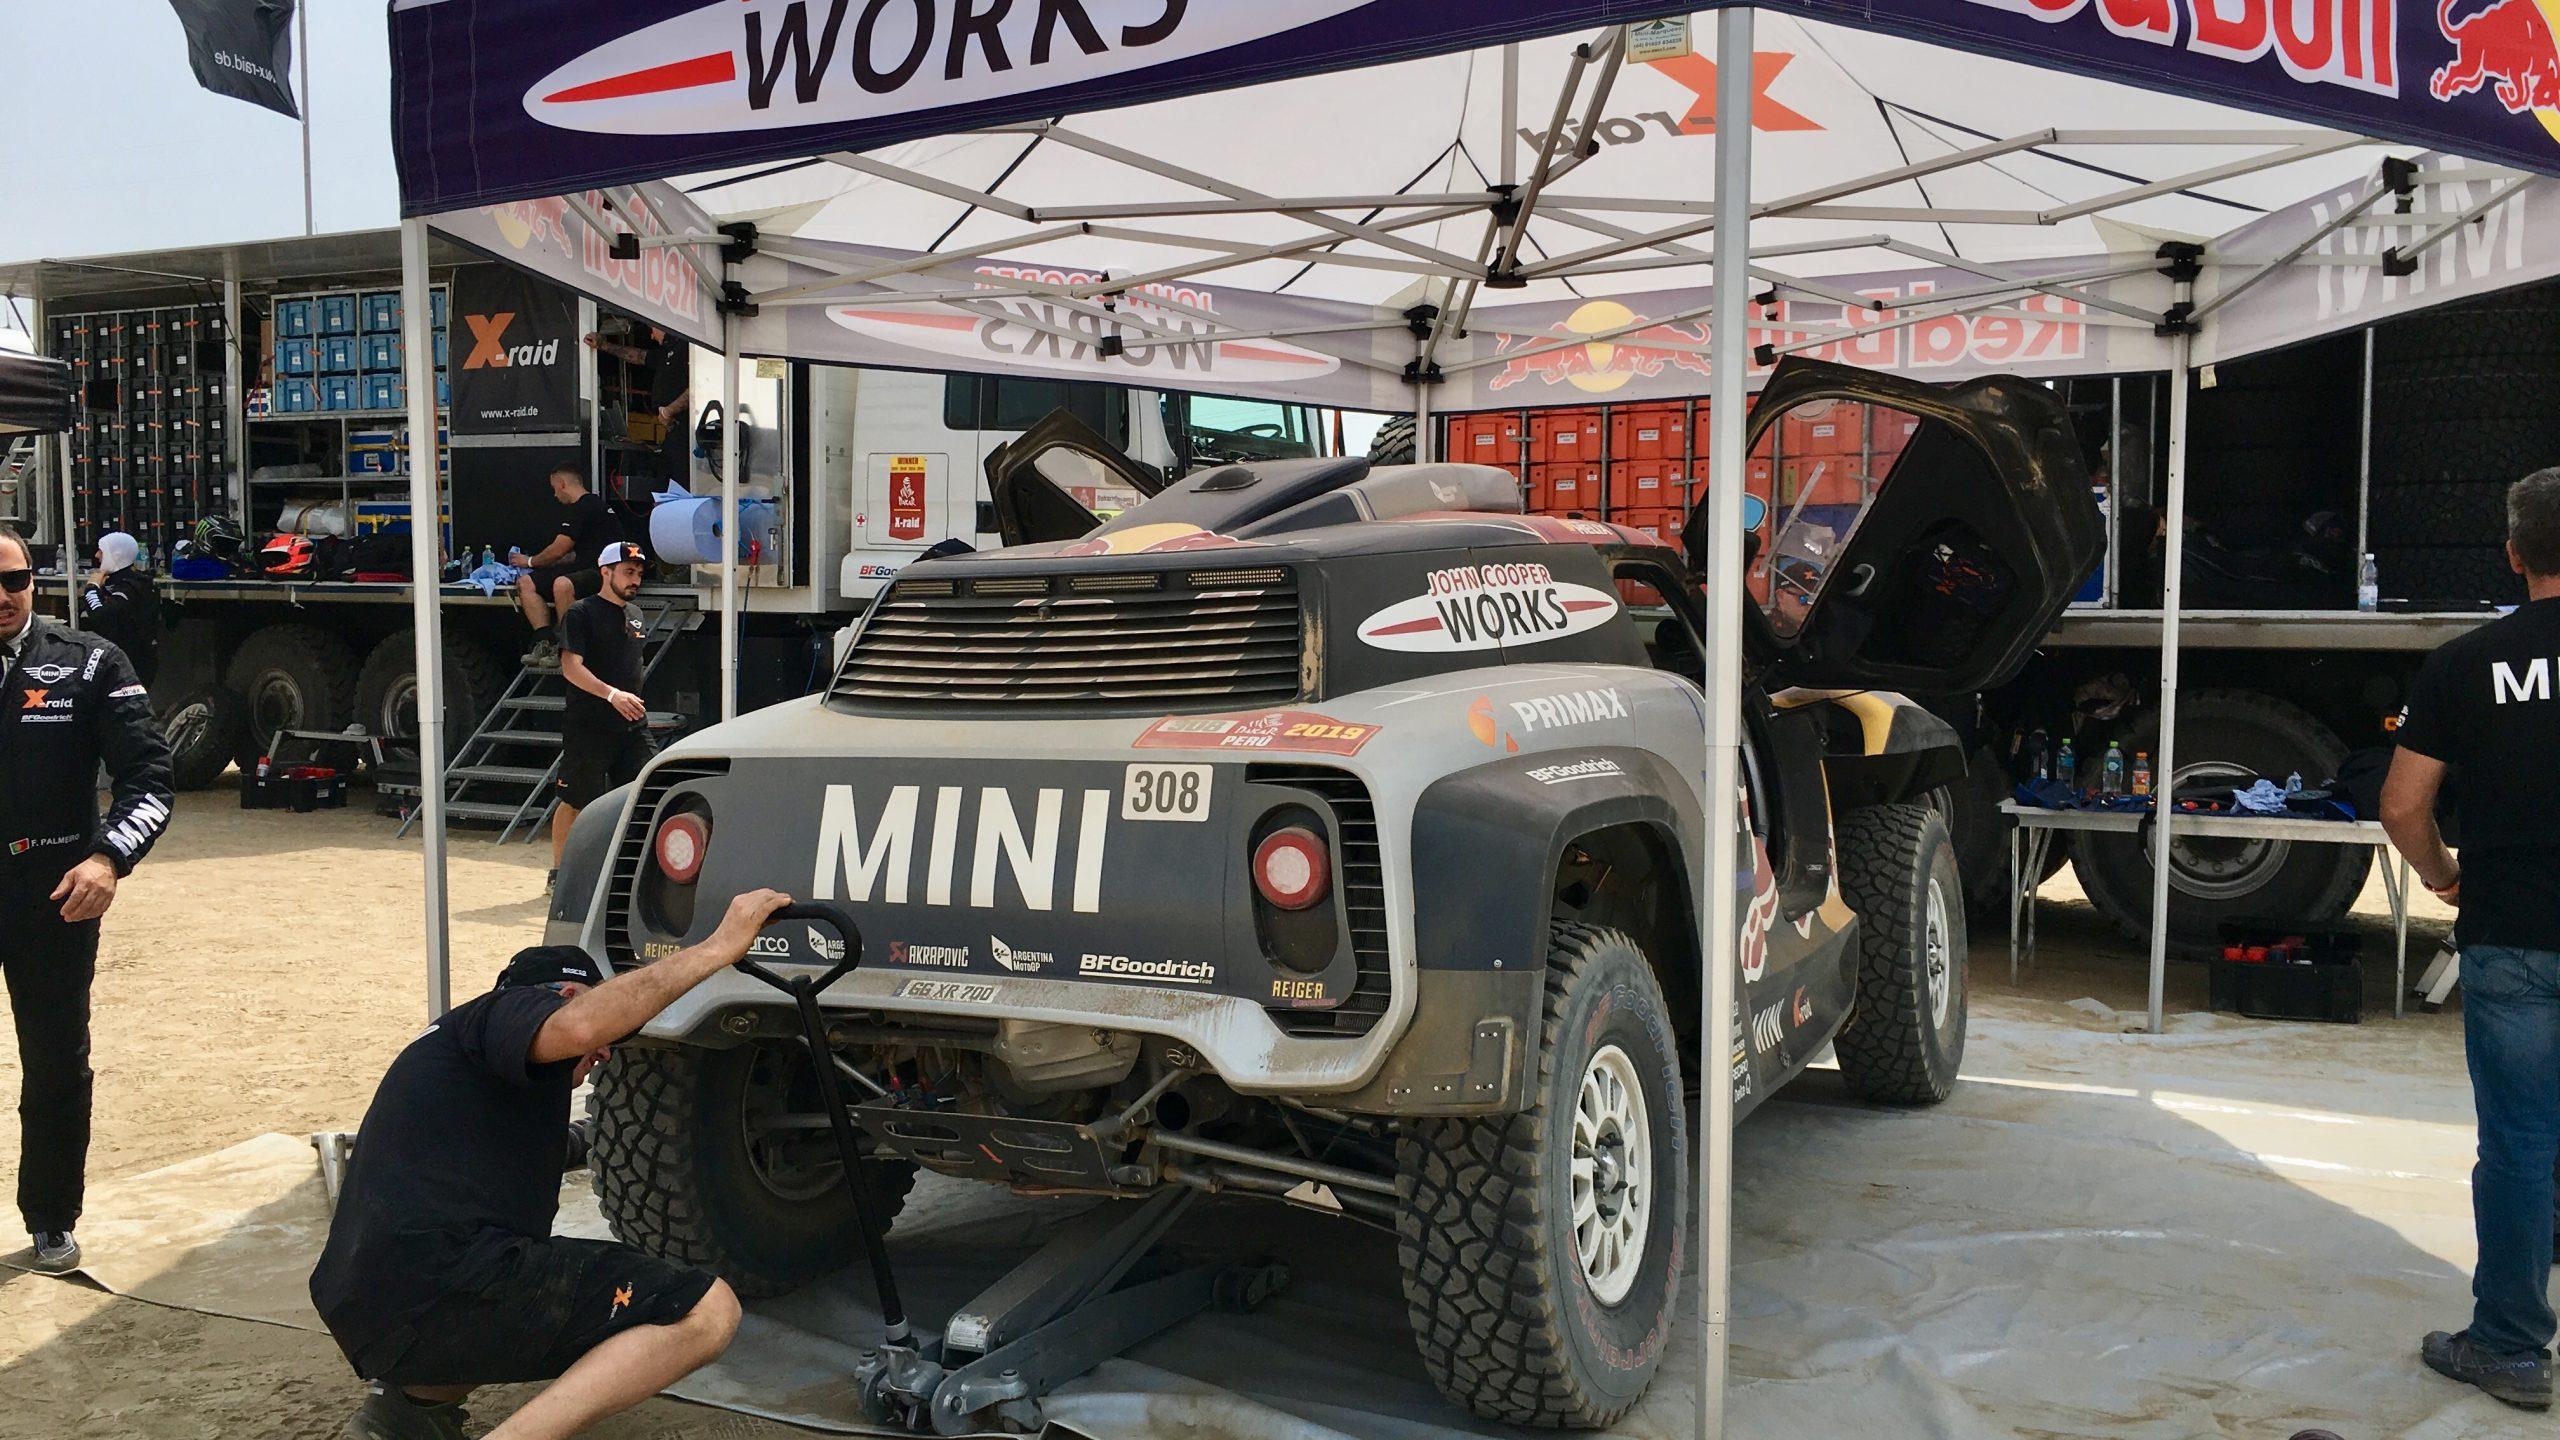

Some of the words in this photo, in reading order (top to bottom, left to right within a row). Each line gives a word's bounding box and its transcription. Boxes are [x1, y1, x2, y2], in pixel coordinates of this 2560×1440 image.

[462, 312, 559, 369] X-raid
[481, 406, 538, 419] www.x-raid.de
[894, 517, 920, 529] X-raid
[860, 565, 898, 577] BFGoo
[1430, 567, 1481, 597] JOHN
[1483, 565, 1551, 588] COOPER
[1436, 588, 1569, 644] WORKS
[2492, 656, 2560, 704] M
[22, 689, 73, 709] X-raid
[1509, 688, 1628, 732] PRIMAX
[1283, 723, 1366, 740] 2019
[1525, 758, 1621, 782] BFGoodrich
[1132, 771, 1200, 813] 308
[106, 792, 170, 857] MINI
[41, 833, 80, 846] PALMEIRO
[813, 784, 1110, 913] MINI
[750, 936, 789, 952] arco
[828, 939, 845, 950] ARGE
[1012, 950, 1054, 964] ARGENTINA
[1080, 954, 1215, 978] BFGoodrich
[934, 983, 960, 999] XR
[1272, 980, 1324, 999] REIGER
[1752, 998, 1785, 1054] MINI
